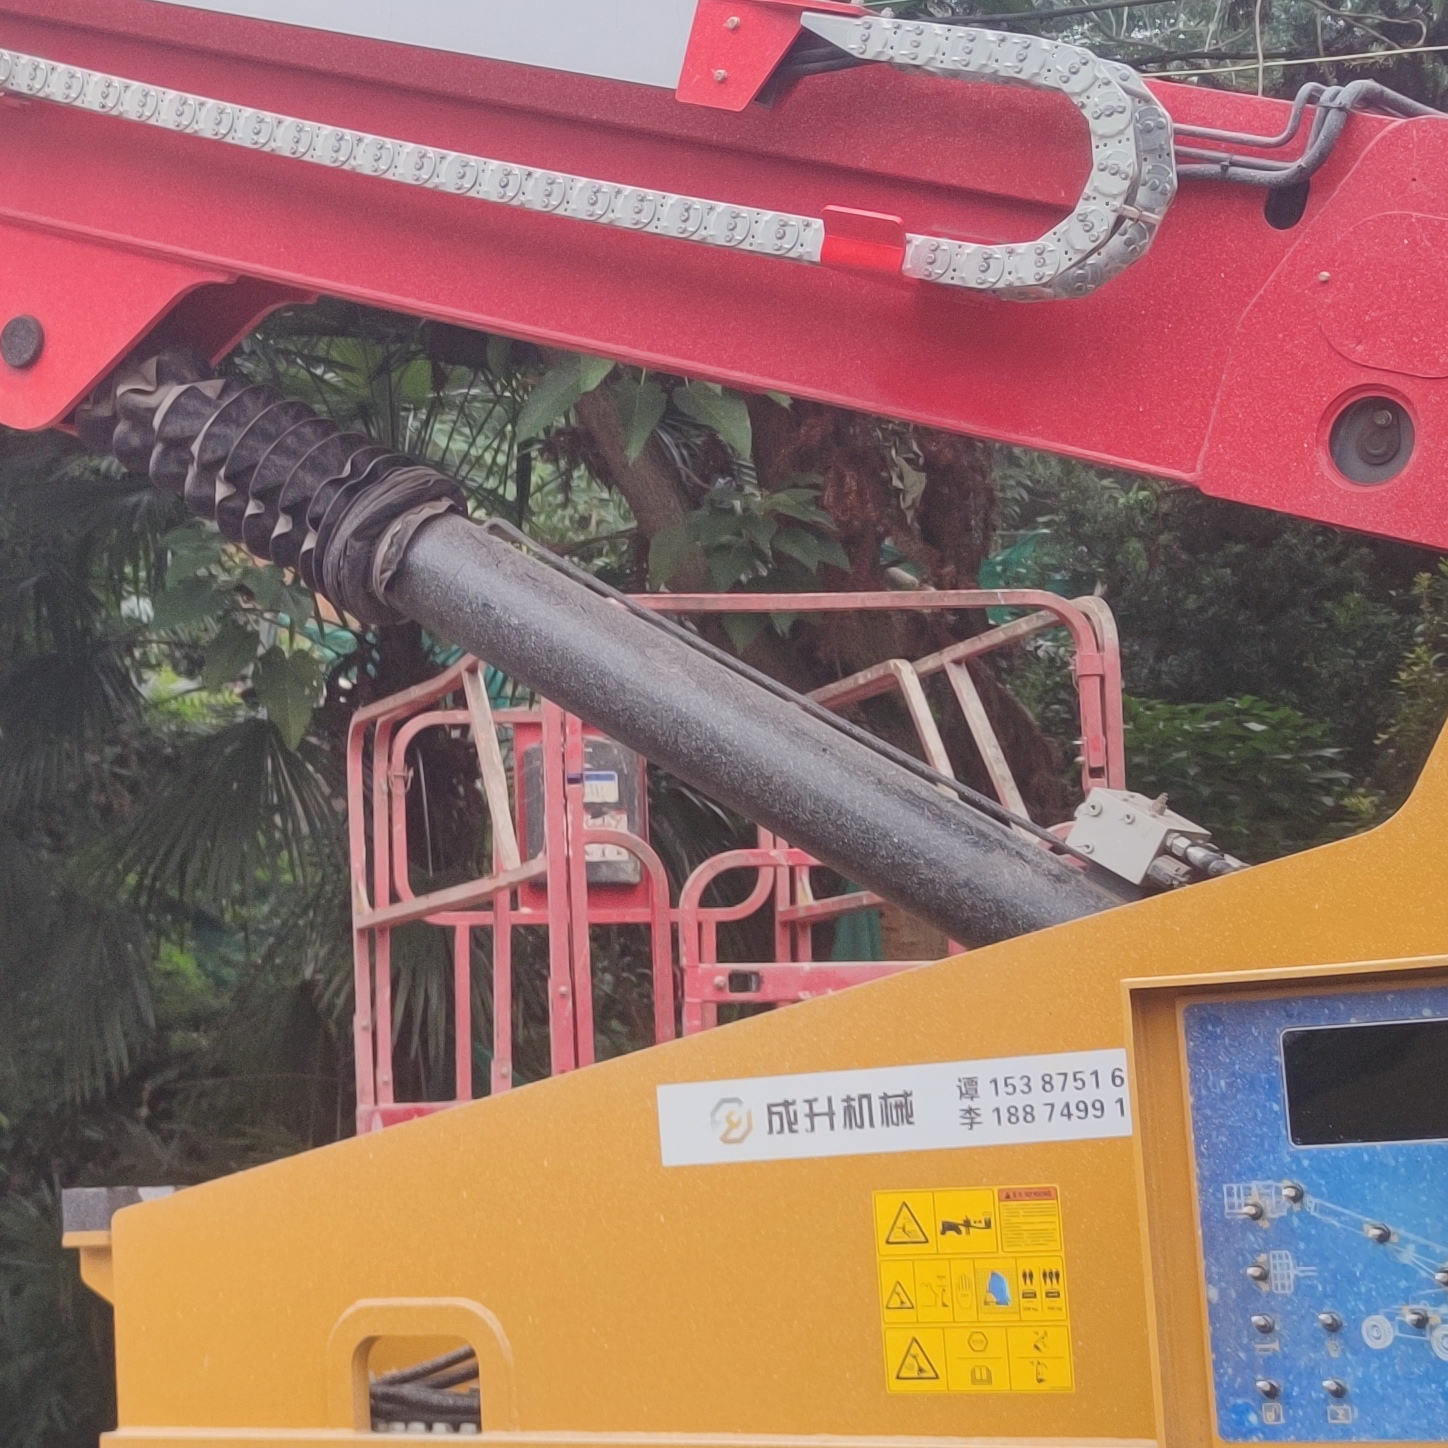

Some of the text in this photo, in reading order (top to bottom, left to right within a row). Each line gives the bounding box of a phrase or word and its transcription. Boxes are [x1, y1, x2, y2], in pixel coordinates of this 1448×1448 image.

[956, 1067, 1125, 1102] 谭 153 8751 6
[765, 1089, 915, 1136] 成升机械
[959, 1097, 1126, 1131] 李 188 7499 1
